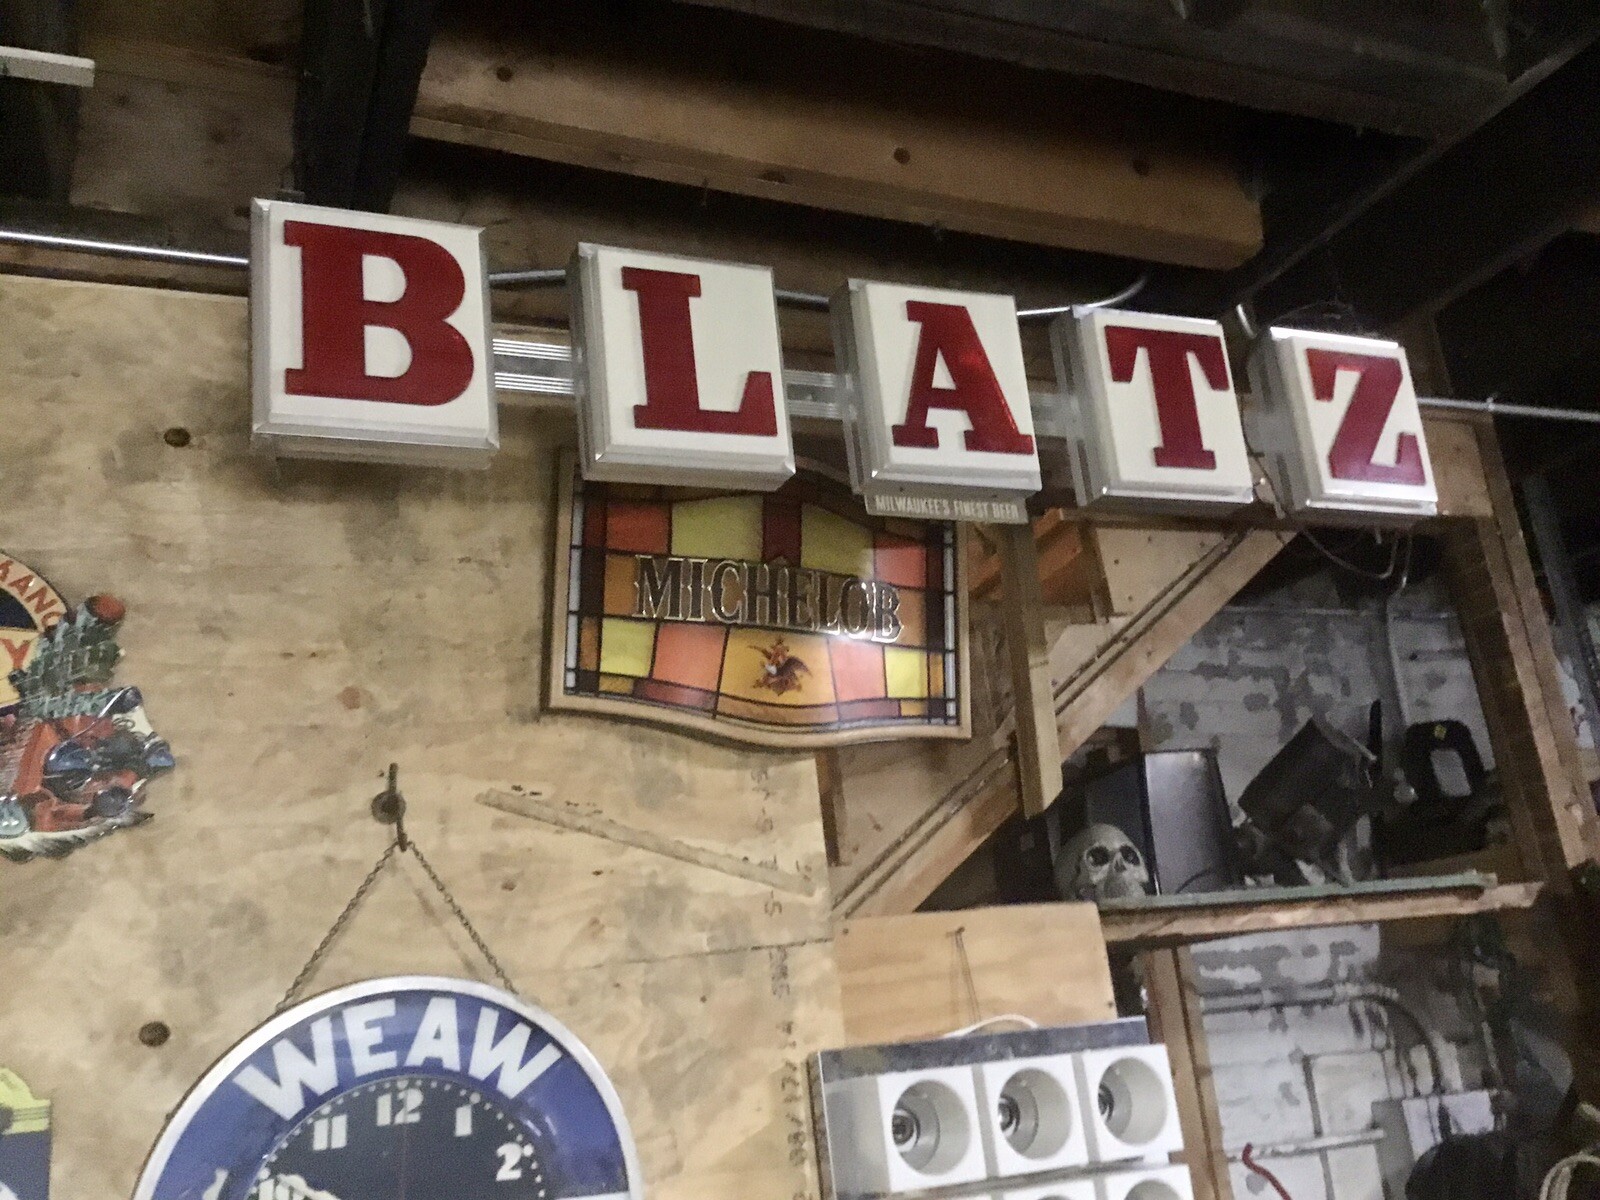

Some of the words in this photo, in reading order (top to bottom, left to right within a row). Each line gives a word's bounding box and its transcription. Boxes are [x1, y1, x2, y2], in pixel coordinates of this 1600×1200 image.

[284, 220, 1426, 485] BLATZ
[875, 494, 950, 516] MILWAUKEE'S
[953, 499, 989, 519] FINEST
[992, 501, 1019, 520] BEER
[634, 555, 905, 644] MICHELOB
[233, 997, 563, 1121] WEAW
[377, 1088, 424, 1126] 12
[455, 1103, 472, 1137] 1
[313, 1114, 347, 1150] 11
[496, 1142, 522, 1181] 2
